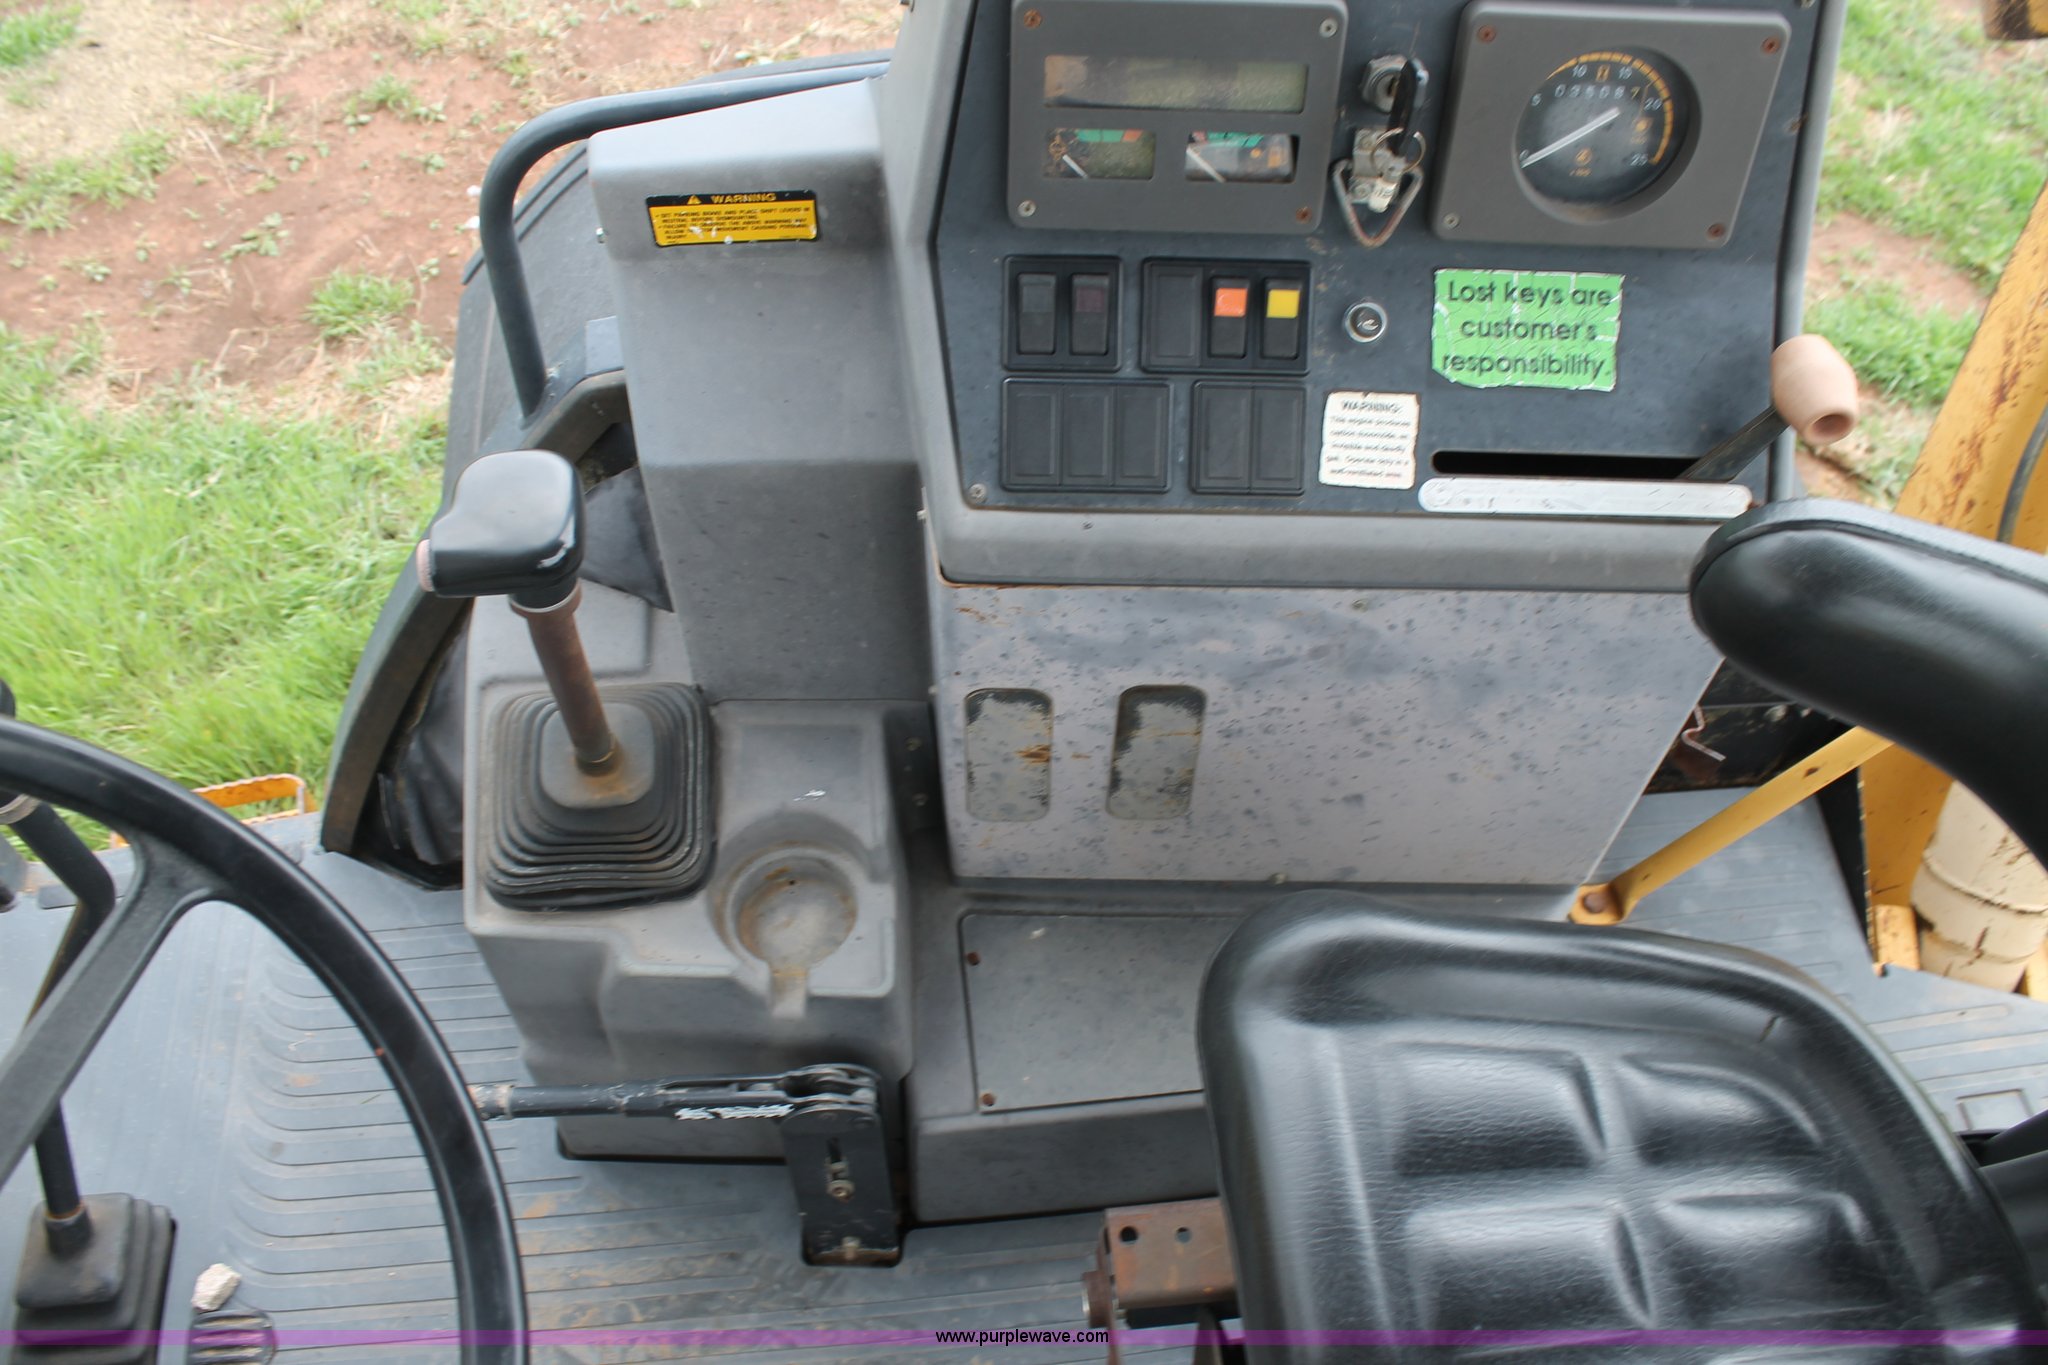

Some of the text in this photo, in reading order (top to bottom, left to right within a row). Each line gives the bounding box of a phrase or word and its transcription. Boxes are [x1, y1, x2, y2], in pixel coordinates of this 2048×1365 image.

[1572, 64, 1587, 78] 10
[1619, 65, 1632, 79] 15
[1644, 97, 1662, 111] 20
[1630, 152, 1648, 166] 25
[710, 193, 776, 204] WARNING
[1449, 281, 1612, 308] Lost keys are
[1460, 318, 1598, 341] customer's
[1443, 353, 1611, 380] responsibility.
